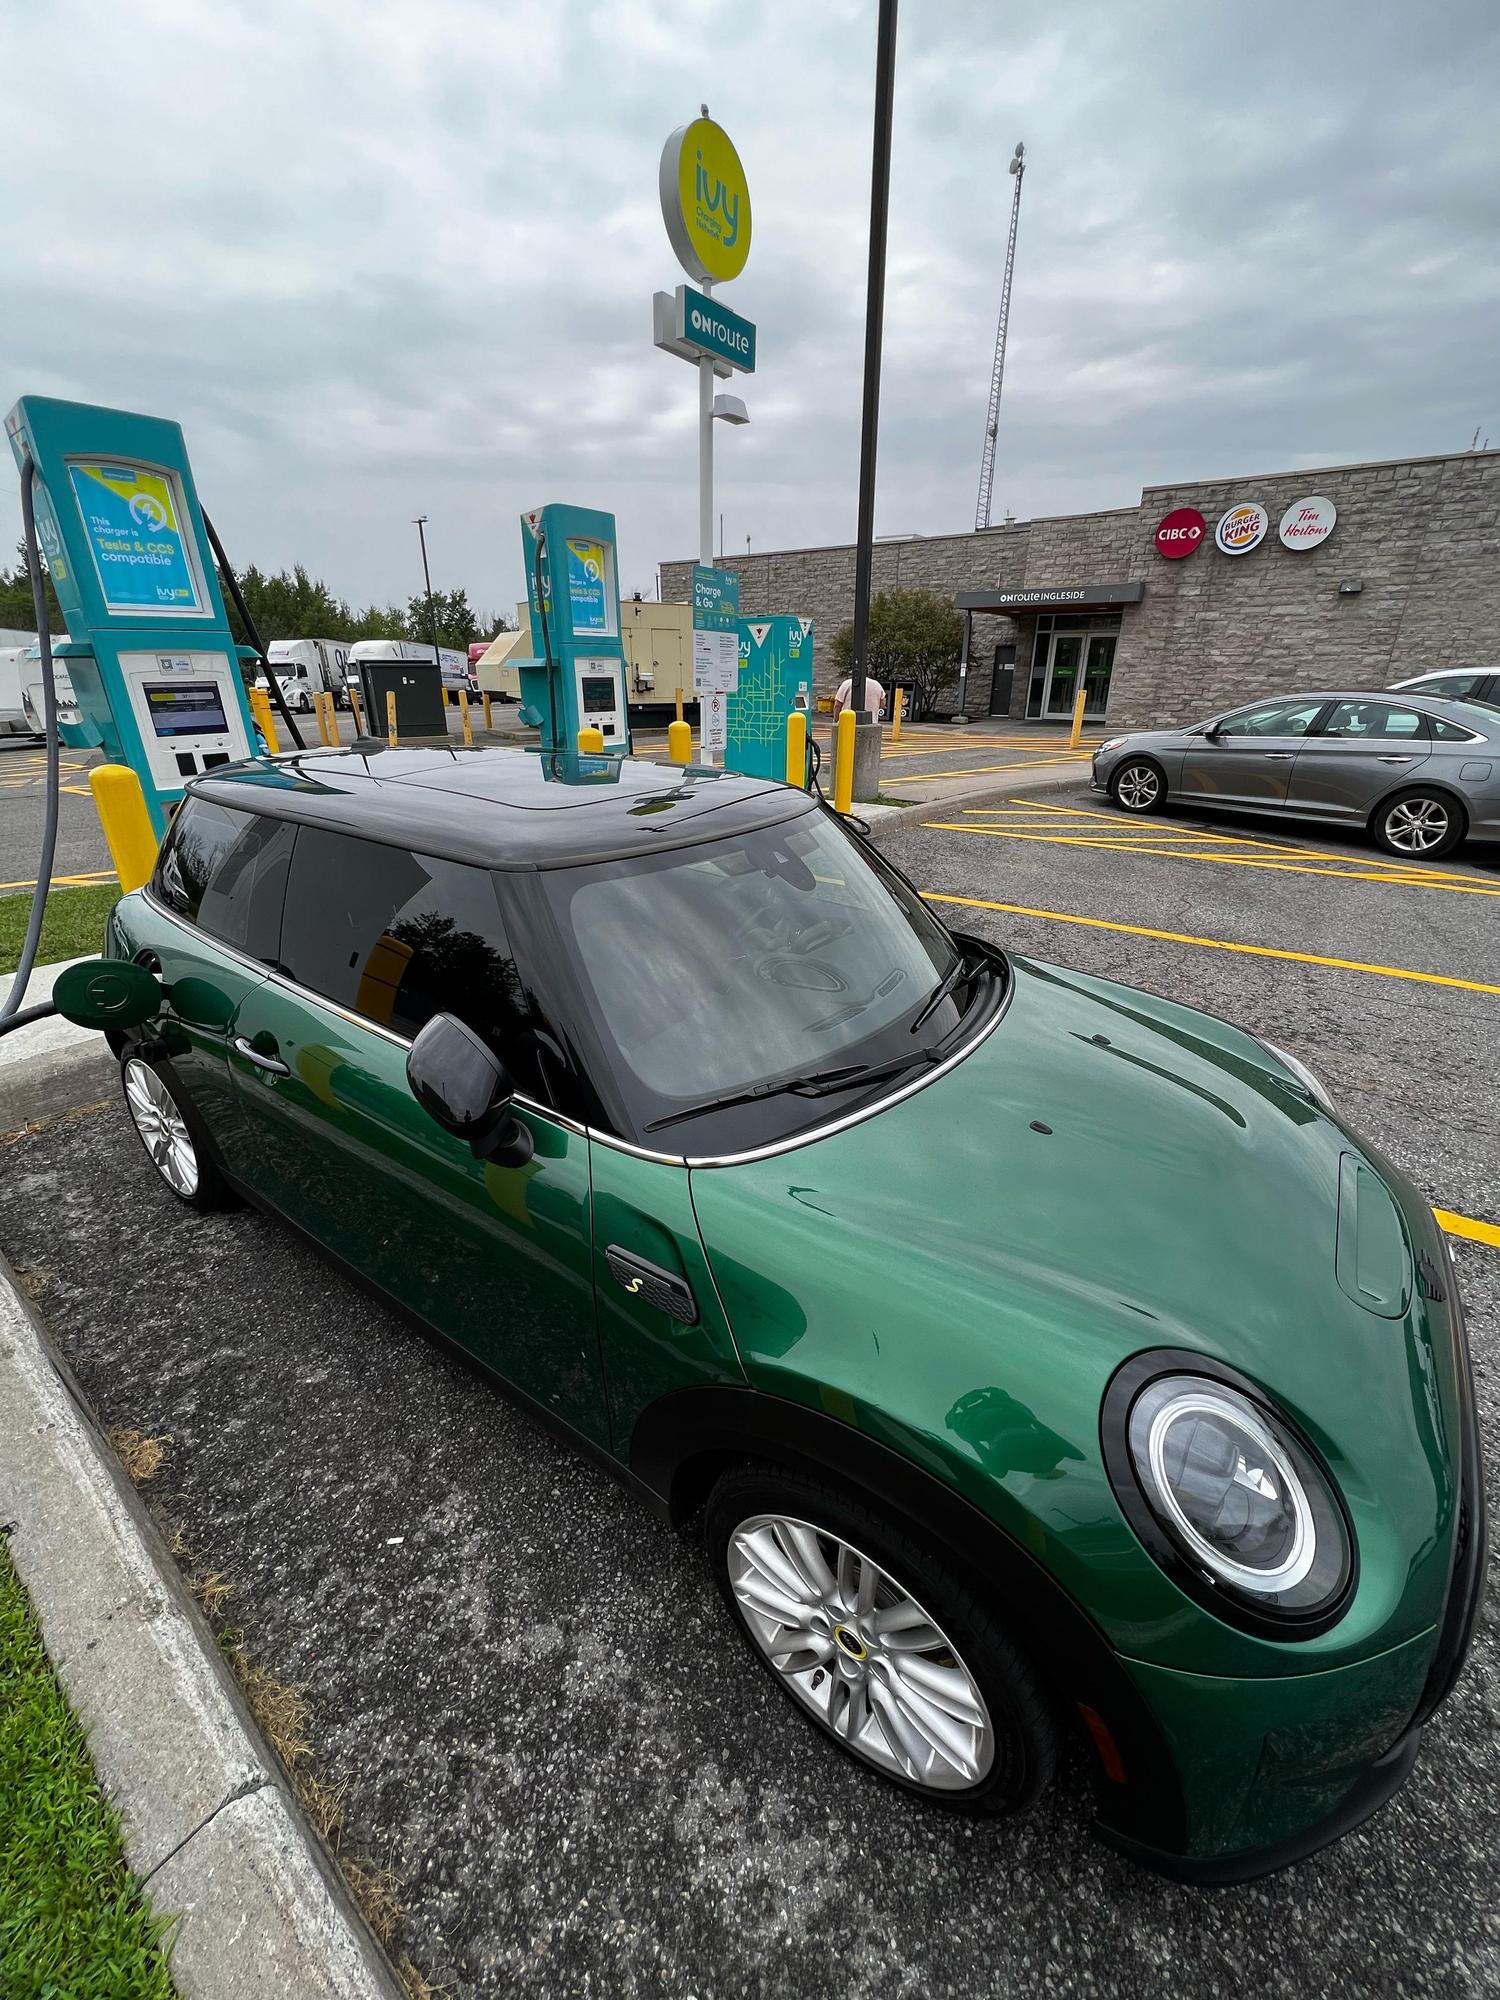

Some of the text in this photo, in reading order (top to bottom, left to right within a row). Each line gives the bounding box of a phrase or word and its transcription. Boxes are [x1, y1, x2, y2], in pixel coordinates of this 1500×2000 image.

[696, 149, 738, 247] ivy
[691, 309, 749, 354] ONroute
[90, 516, 110, 526] This
[1224, 513, 1260, 531] BURGER
[1298, 508, 1320, 522] Tim
[93, 527, 139, 537] charger is
[1158, 527, 1188, 541] CIBC
[1224, 520, 1261, 542] KING
[1283, 524, 1328, 537] Hortons
[97, 538, 175, 554] Tesla & CCS
[101, 553, 172, 566] compatible
[156, 585, 175, 600] ivy
[695, 582, 721, 599] Charge
[1000, 591, 1086, 602] ONroute INGLESIDE
[695, 596, 713, 608] & Go
[789, 627, 802, 647] ivy
[625, 1278, 643, 1293] S
